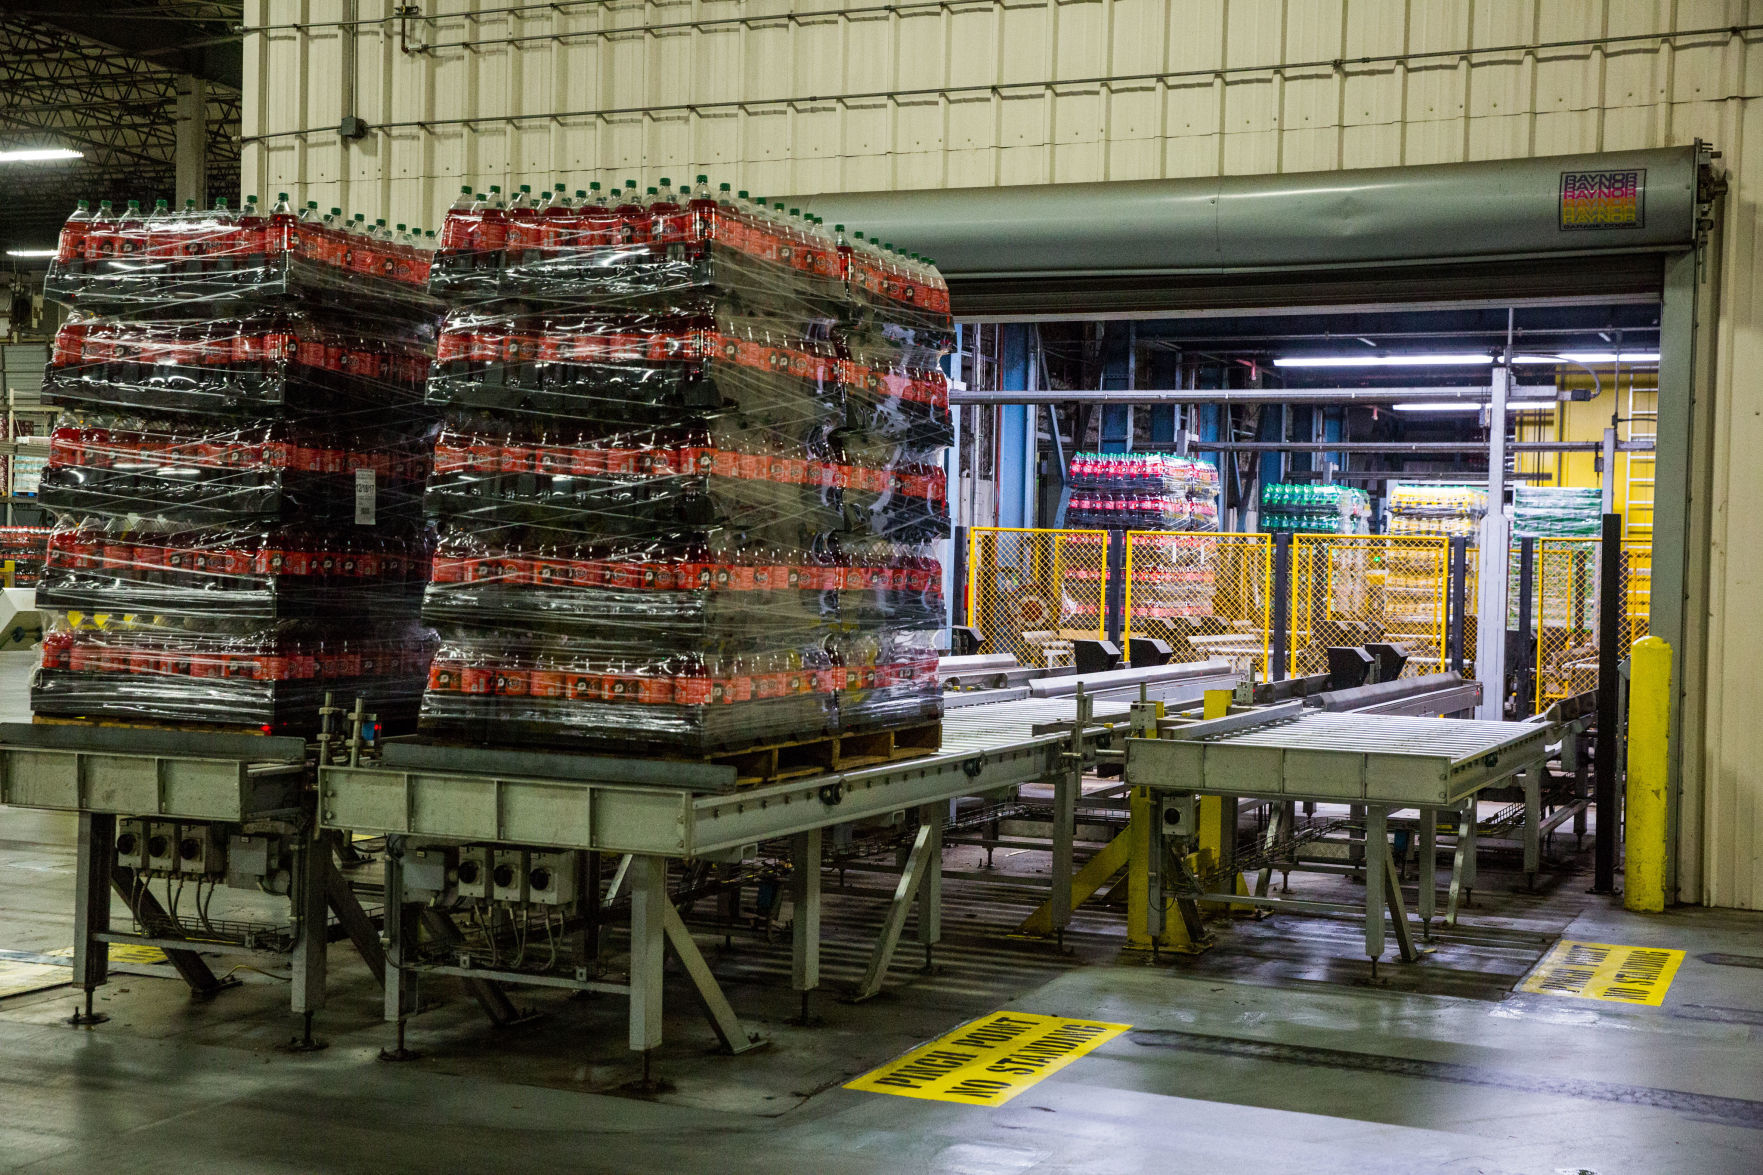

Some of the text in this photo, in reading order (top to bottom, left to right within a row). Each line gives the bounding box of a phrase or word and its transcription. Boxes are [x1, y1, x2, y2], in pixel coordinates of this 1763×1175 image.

[1565, 173, 1637, 184] RAYNOR
[1564, 180, 1637, 192] RAYNOR
[1564, 189, 1636, 200] RAYNOR
[1563, 197, 1636, 208] RAYNOR
[1563, 215, 1636, 224] RAYNOR
[1539, 945, 1611, 993] PINCH POINT
[1603, 951, 1670, 1000] NO STANDING
[873, 1016, 1040, 1089] PINCH POINT
[943, 1024, 1108, 1098] NO STANDING
